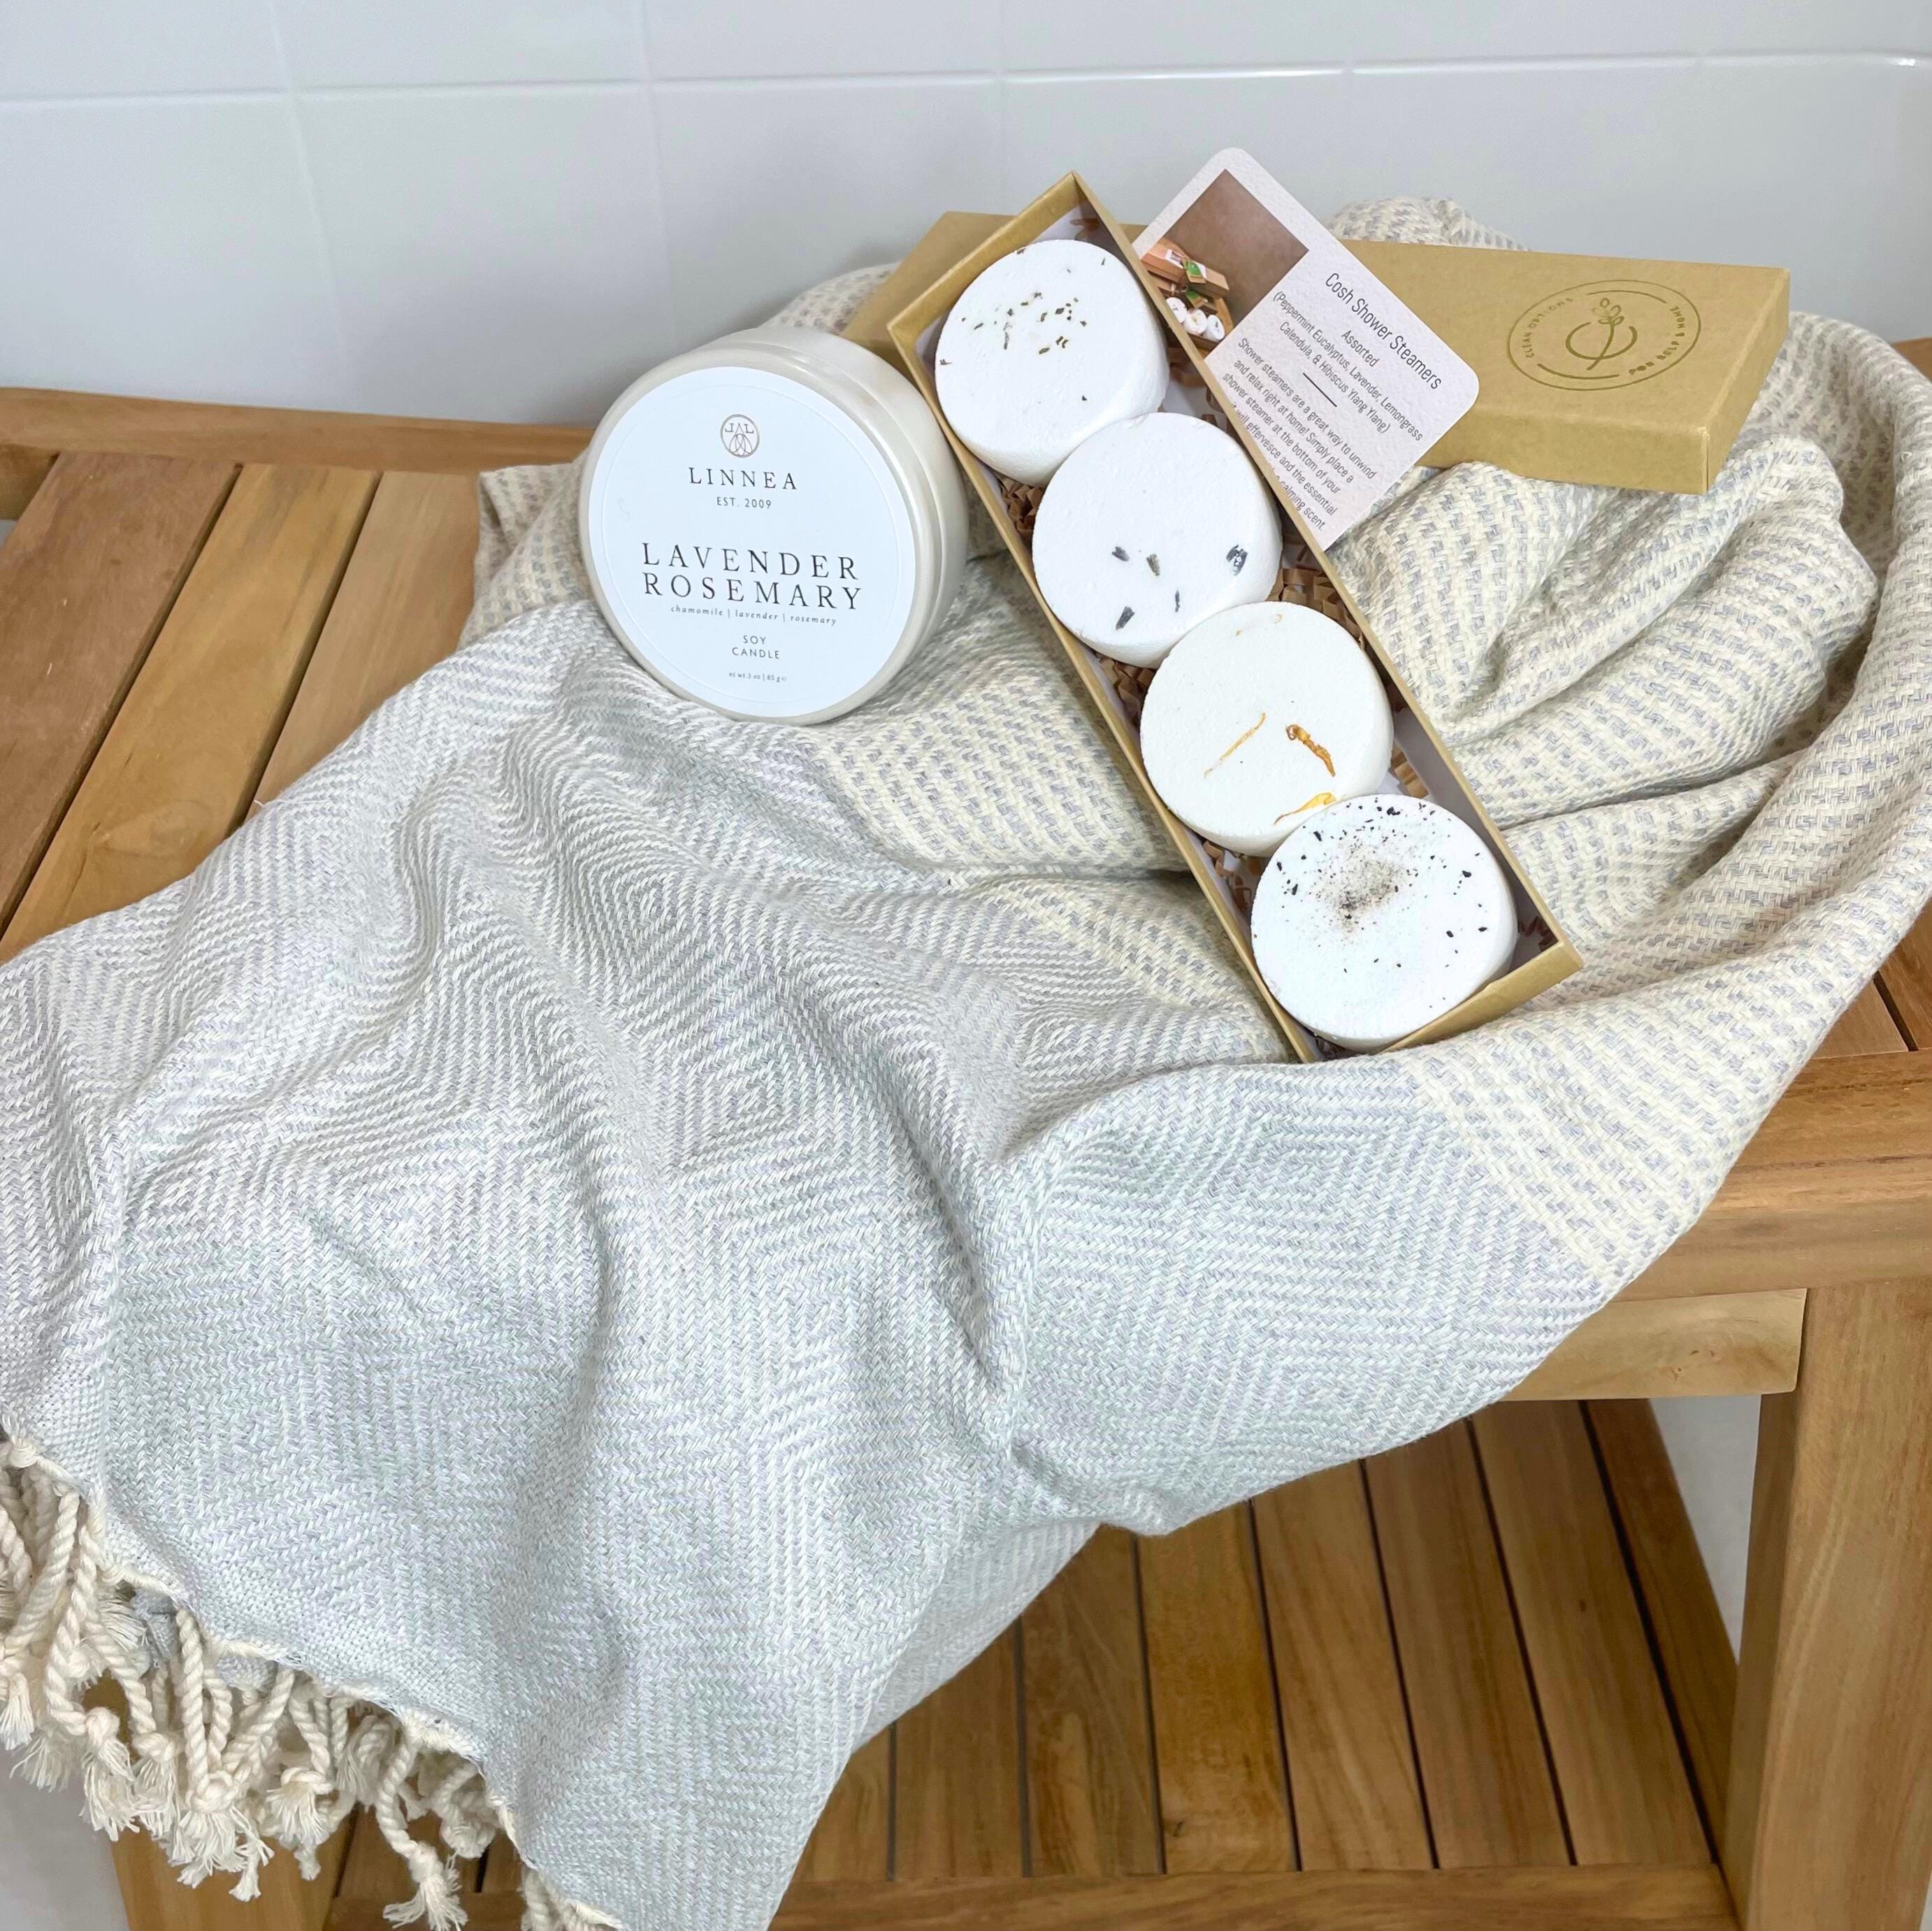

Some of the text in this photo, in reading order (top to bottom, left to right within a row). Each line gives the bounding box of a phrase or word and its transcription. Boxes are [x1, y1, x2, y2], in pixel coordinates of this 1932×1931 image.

[1325, 273, 1442, 389] Cosh Shower Steamers
[1341, 329, 1380, 368] Assorted
[1521, 331, 1534, 359] CLEAN
[1272, 291, 1423, 441] (Peppermint Eucalyptus, Lavender, Lemongrass
[1279, 321, 1391, 434] Calendula, & Hibiscus Ylang Ylang)
[1234, 359, 1354, 484] and relax right at home! Simply place a
[1238, 338, 1378, 480] Shower steamers are a great way to unwind
[1222, 373, 1341, 494] shower steamer at the bottom of your
[689, 467, 797, 489] LINNEA
[1246, 422, 1281, 459] effervesce
[1278, 457, 1297, 473] and
[1292, 468, 1306, 484] the
[1303, 482, 1339, 516] essential
[717, 496, 771, 509] EST. 2009
[642, 543, 858, 581] LAVENDER
[642, 570, 861, 611] ROSEMARY
[671, 605, 723, 615] chamomile
[735, 610, 777, 619] lavender
[791, 616, 836, 626] rosemary
[732, 647, 779, 659] CANDLE
[743, 635, 766, 645] SOY
